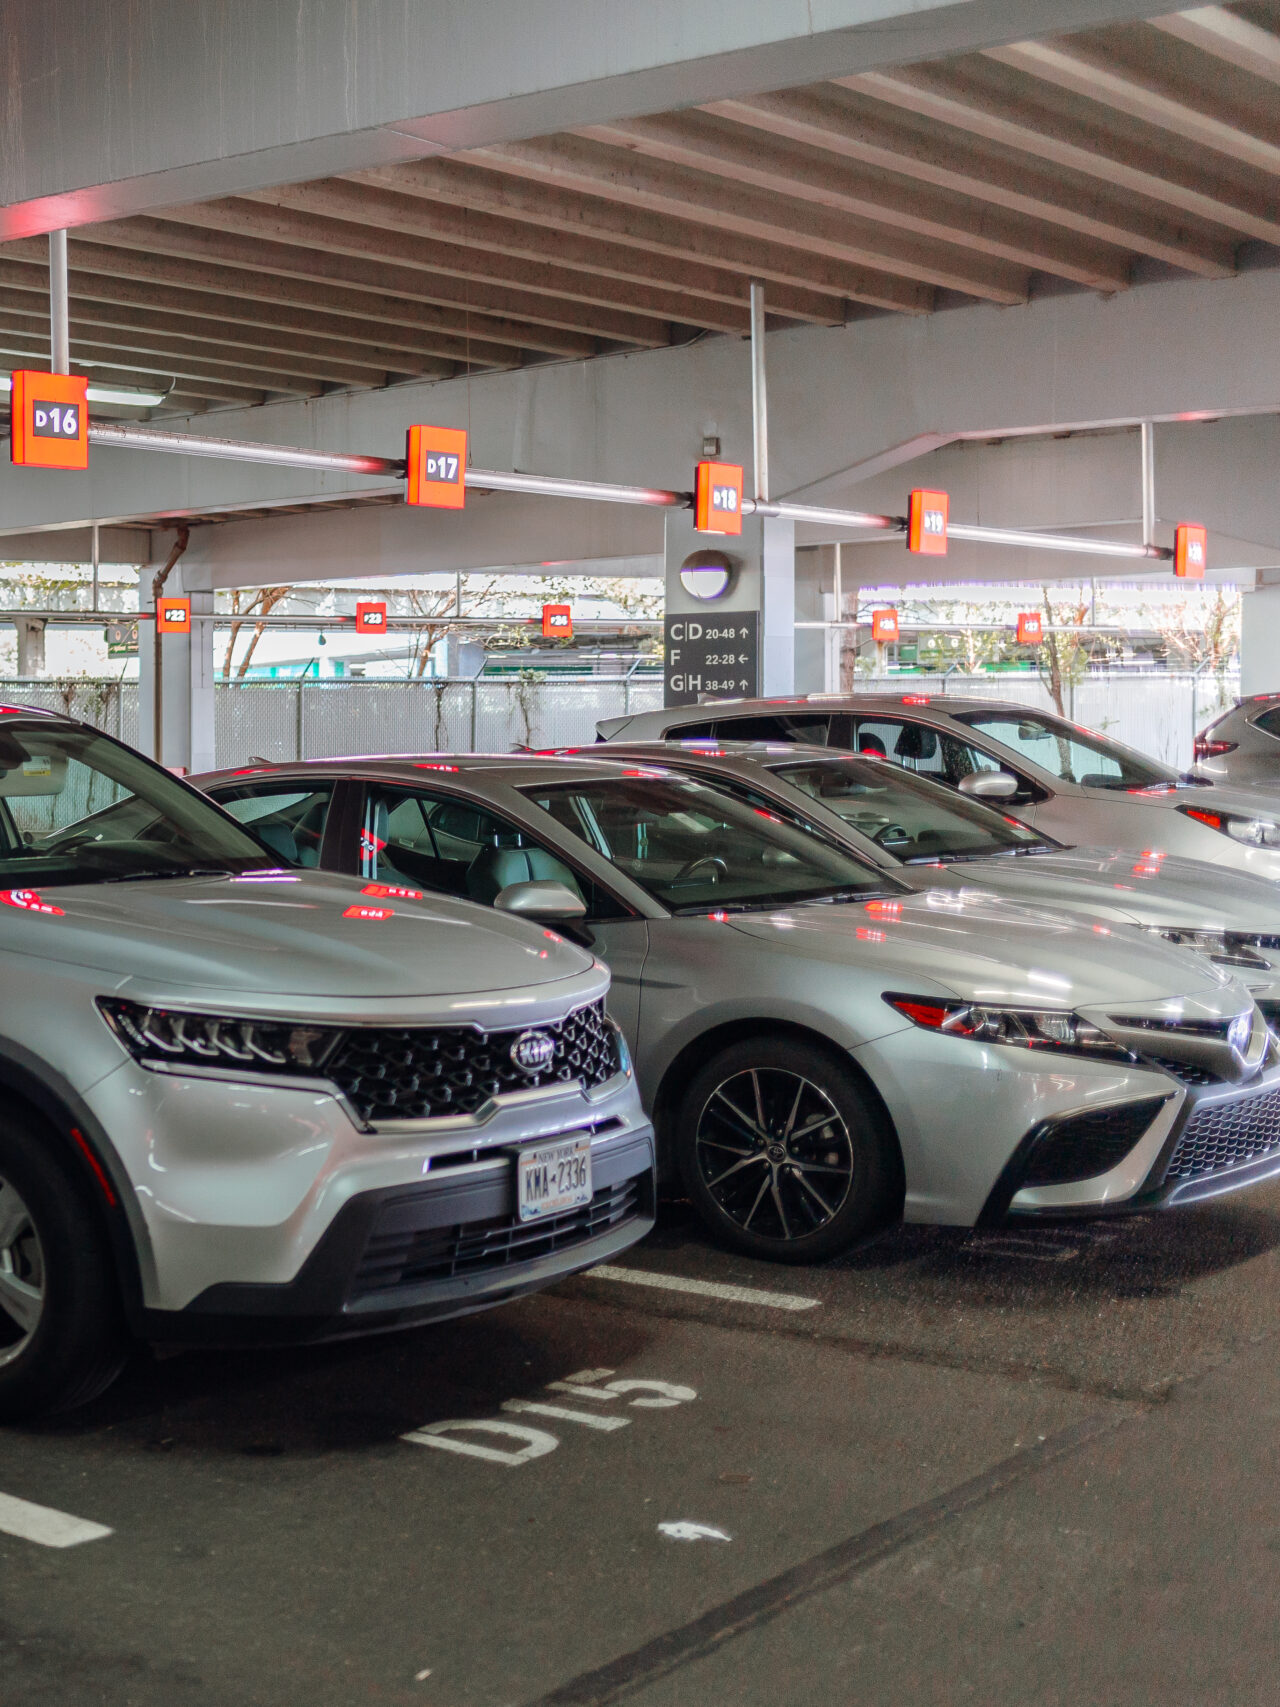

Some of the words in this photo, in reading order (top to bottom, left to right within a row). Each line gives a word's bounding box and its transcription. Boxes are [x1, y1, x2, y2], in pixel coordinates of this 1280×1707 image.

[34, 408, 78, 435] D16
[426, 457, 458, 479] D17
[713, 489, 738, 510] D18
[165, 609, 186, 622] F22
[705, 628, 735, 640] 20-48
[670, 649, 681, 666] F
[705, 654, 735, 665] 22-28
[705, 679, 735, 691] 38-49
[519, 1040, 552, 1065] KIA
[399, 1367, 697, 1467] D15
